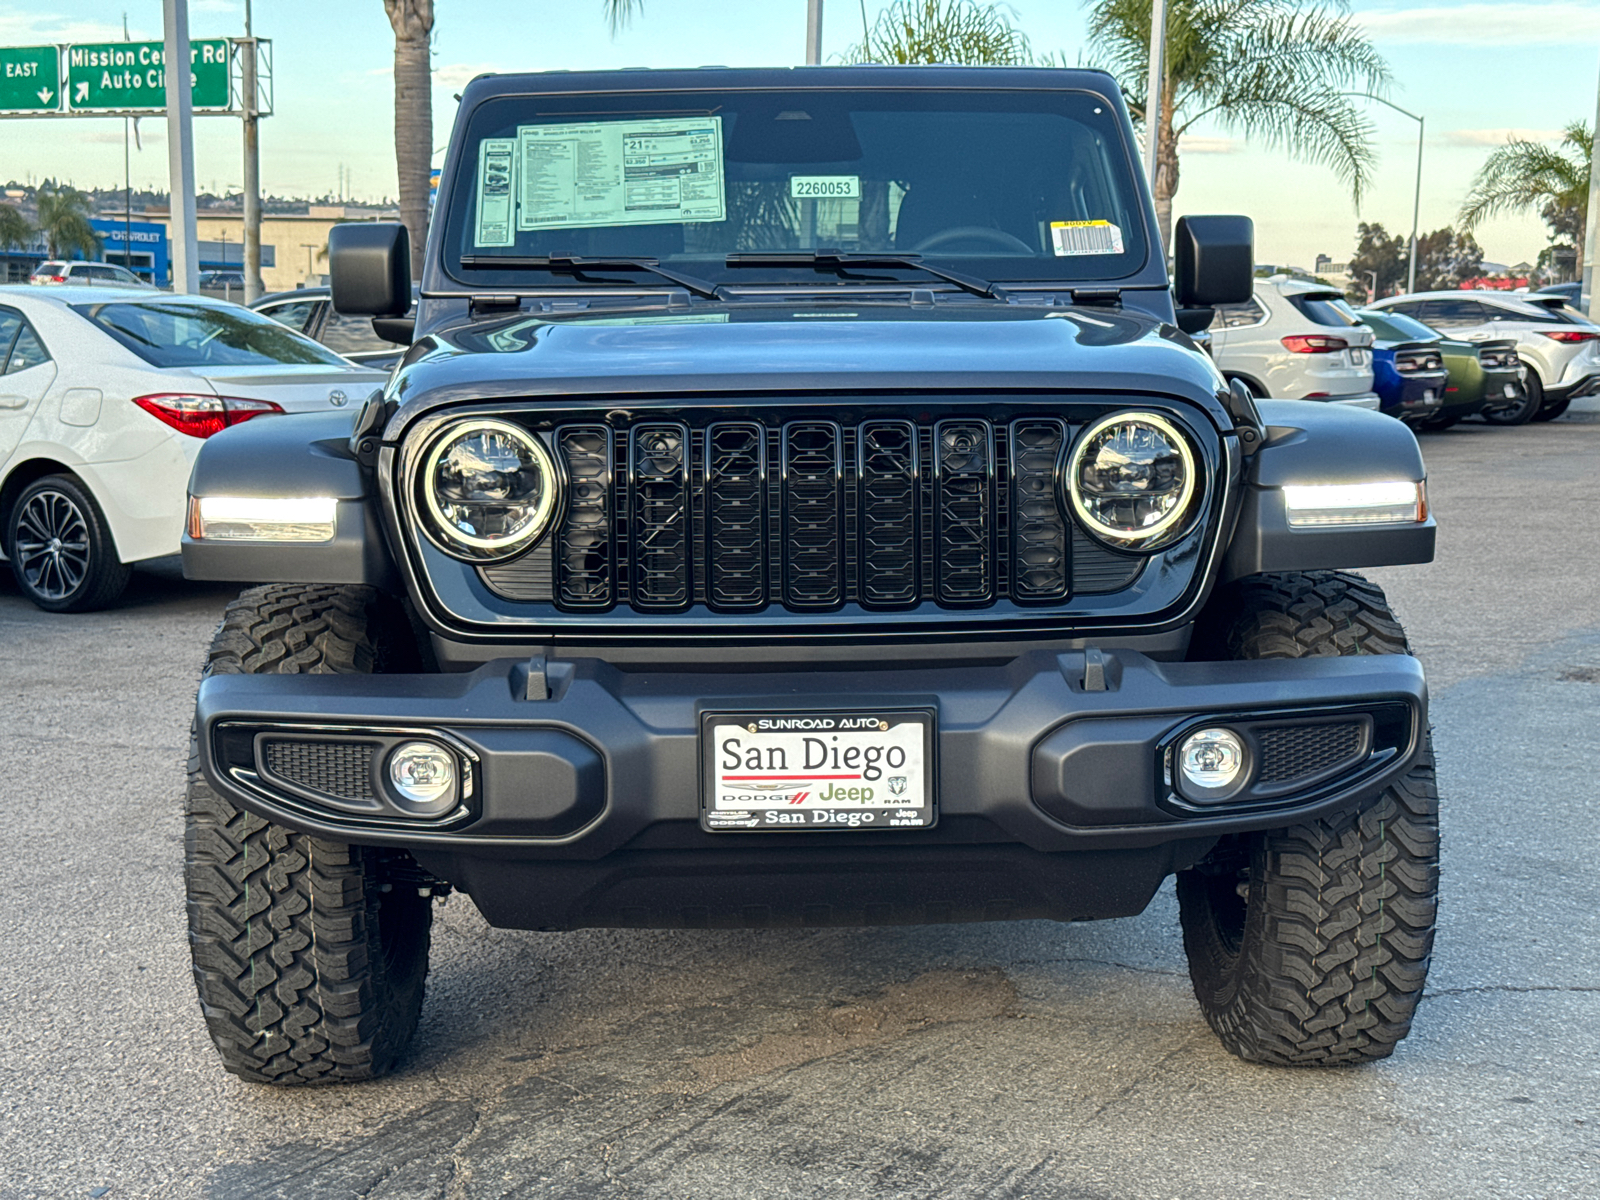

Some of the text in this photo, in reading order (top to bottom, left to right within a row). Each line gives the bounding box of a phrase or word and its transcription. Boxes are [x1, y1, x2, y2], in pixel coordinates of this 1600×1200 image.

[71, 44, 226, 67] Mission Cer Rd
[6, 62, 38, 78] EAST
[100, 69, 198, 89] Auto Cie
[629, 140, 643, 149] 21
[796, 182, 851, 195] 2260053
[758, 718, 880, 730] SUNROAD AUTO
[722, 735, 906, 781] San Diego
[819, 783, 875, 804] Jeep
[765, 809, 875, 827] San Diego
[895, 809, 918, 818] Jeep
